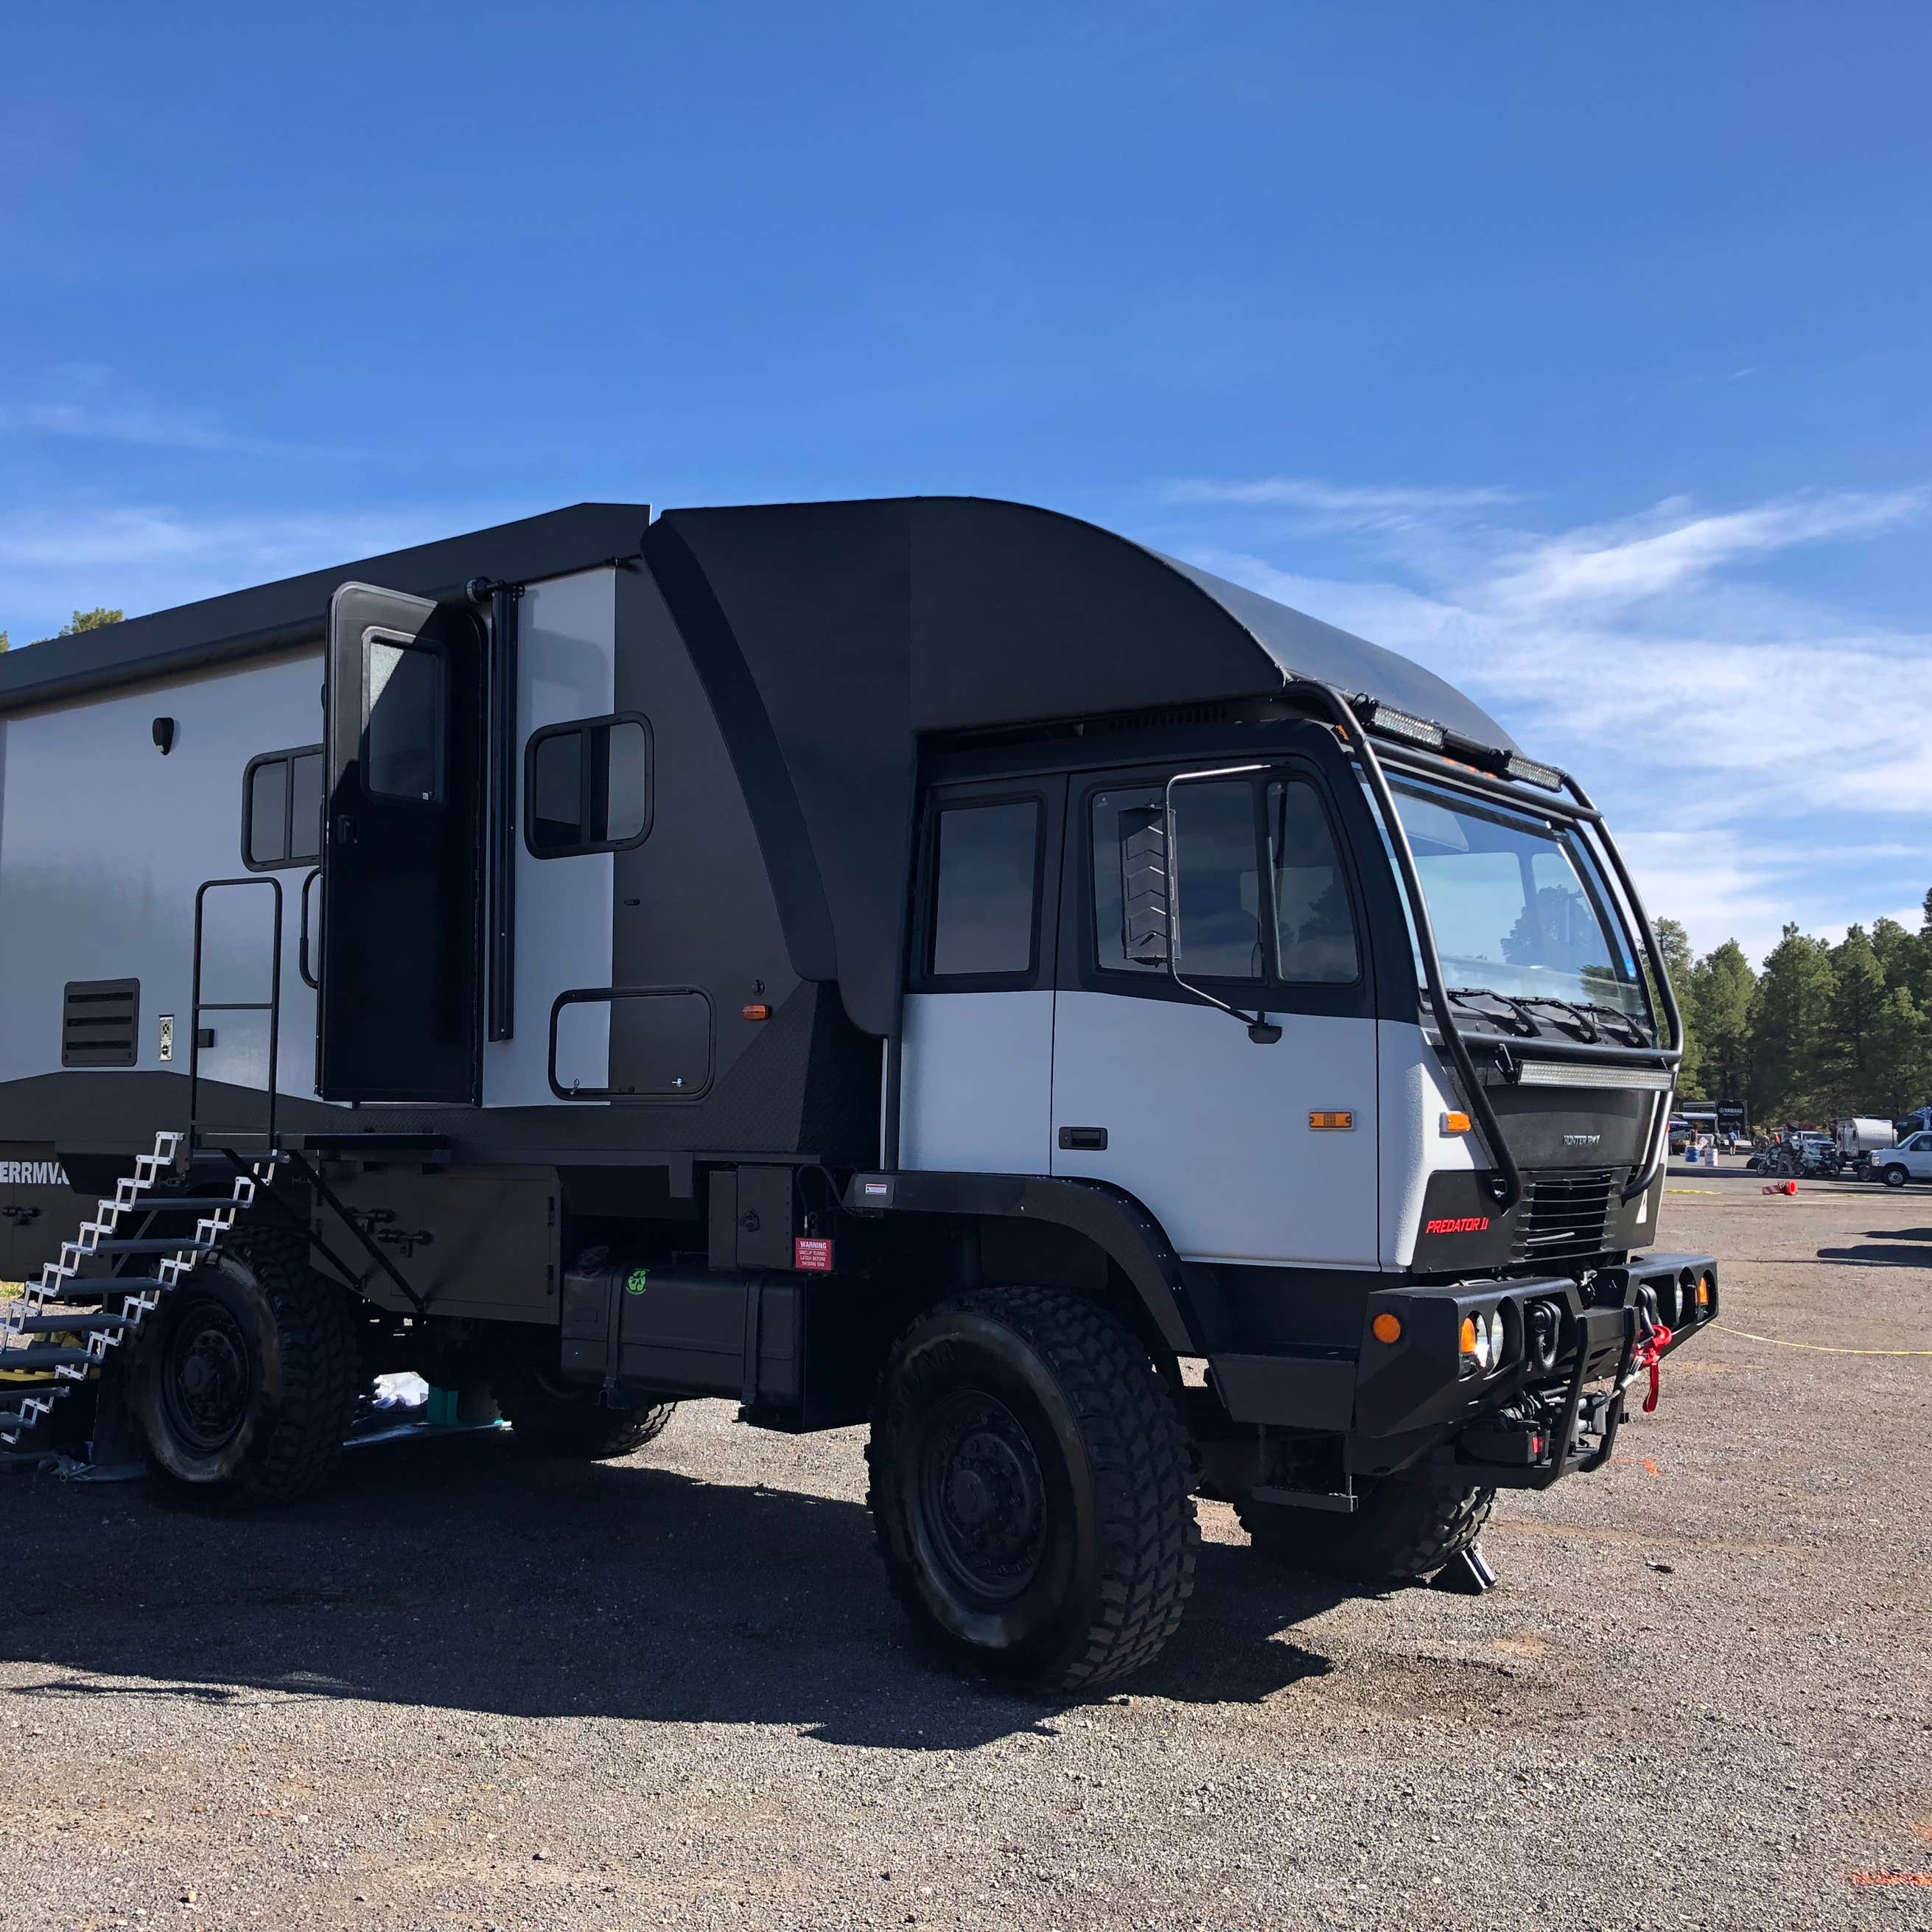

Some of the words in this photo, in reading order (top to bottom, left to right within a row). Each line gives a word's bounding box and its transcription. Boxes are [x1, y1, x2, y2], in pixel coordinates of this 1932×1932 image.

[1426, 1218, 1481, 1233] PREDATOR
[1480, 1217, 1488, 1230] II
[800, 1241, 827, 1249] WARNING
